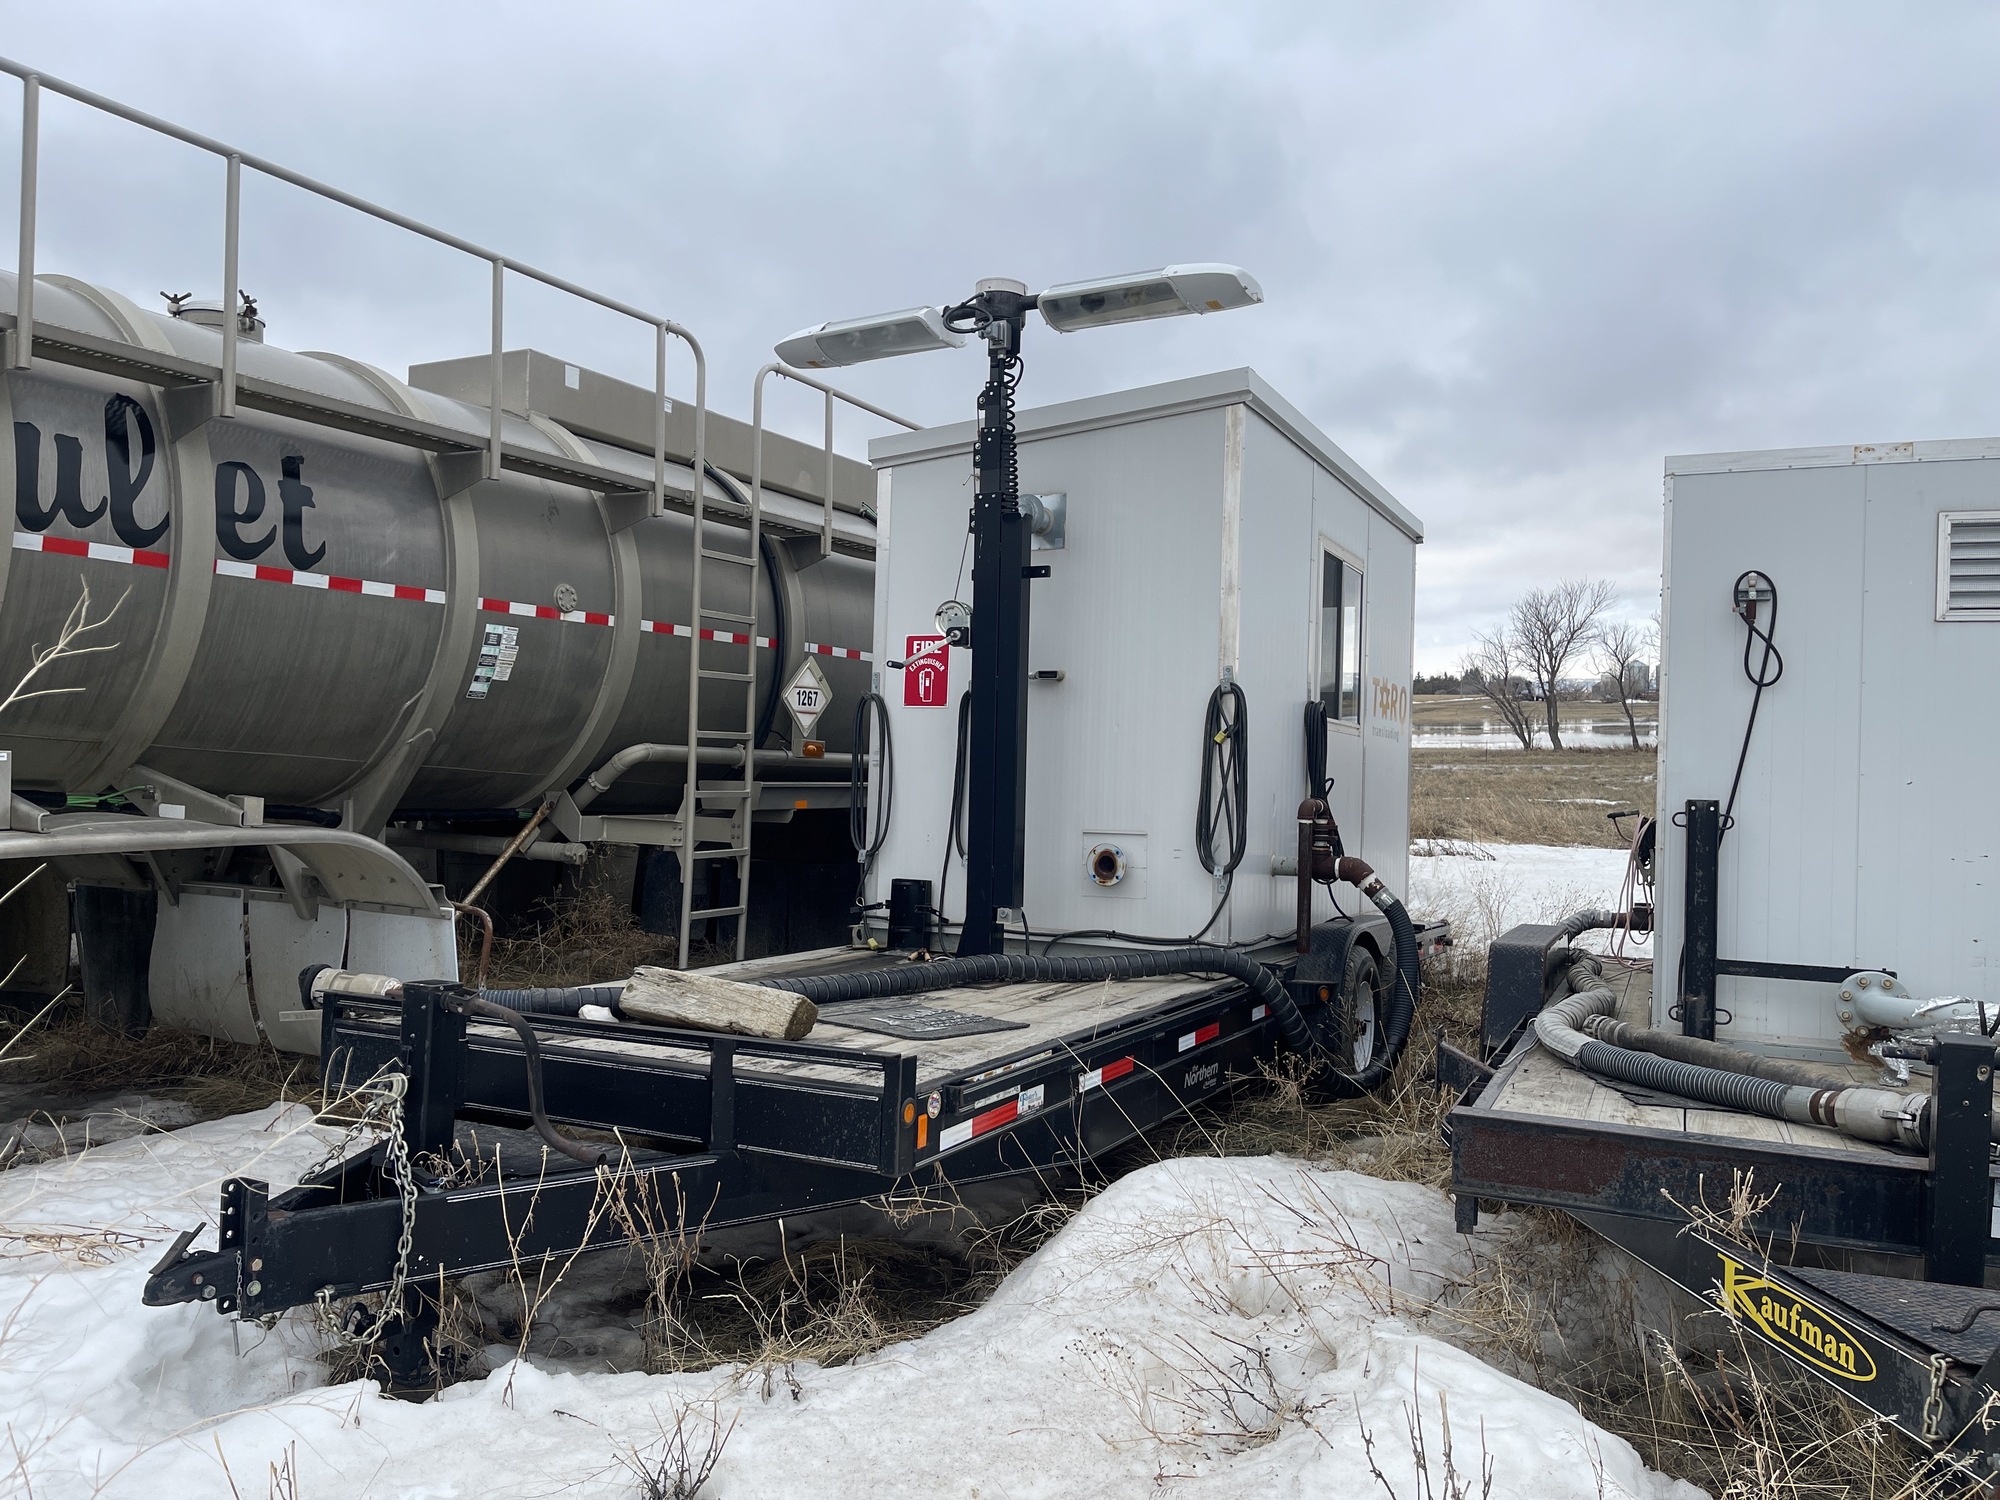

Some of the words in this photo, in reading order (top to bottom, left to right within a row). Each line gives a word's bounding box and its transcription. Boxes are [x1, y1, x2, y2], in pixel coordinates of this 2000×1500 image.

[908, 657, 946, 672] EXTINGUISHER
[796, 689, 819, 707] 1267
[1183, 1062, 1219, 1089] Northern
[1716, 1252, 1858, 1375] Kaufman
